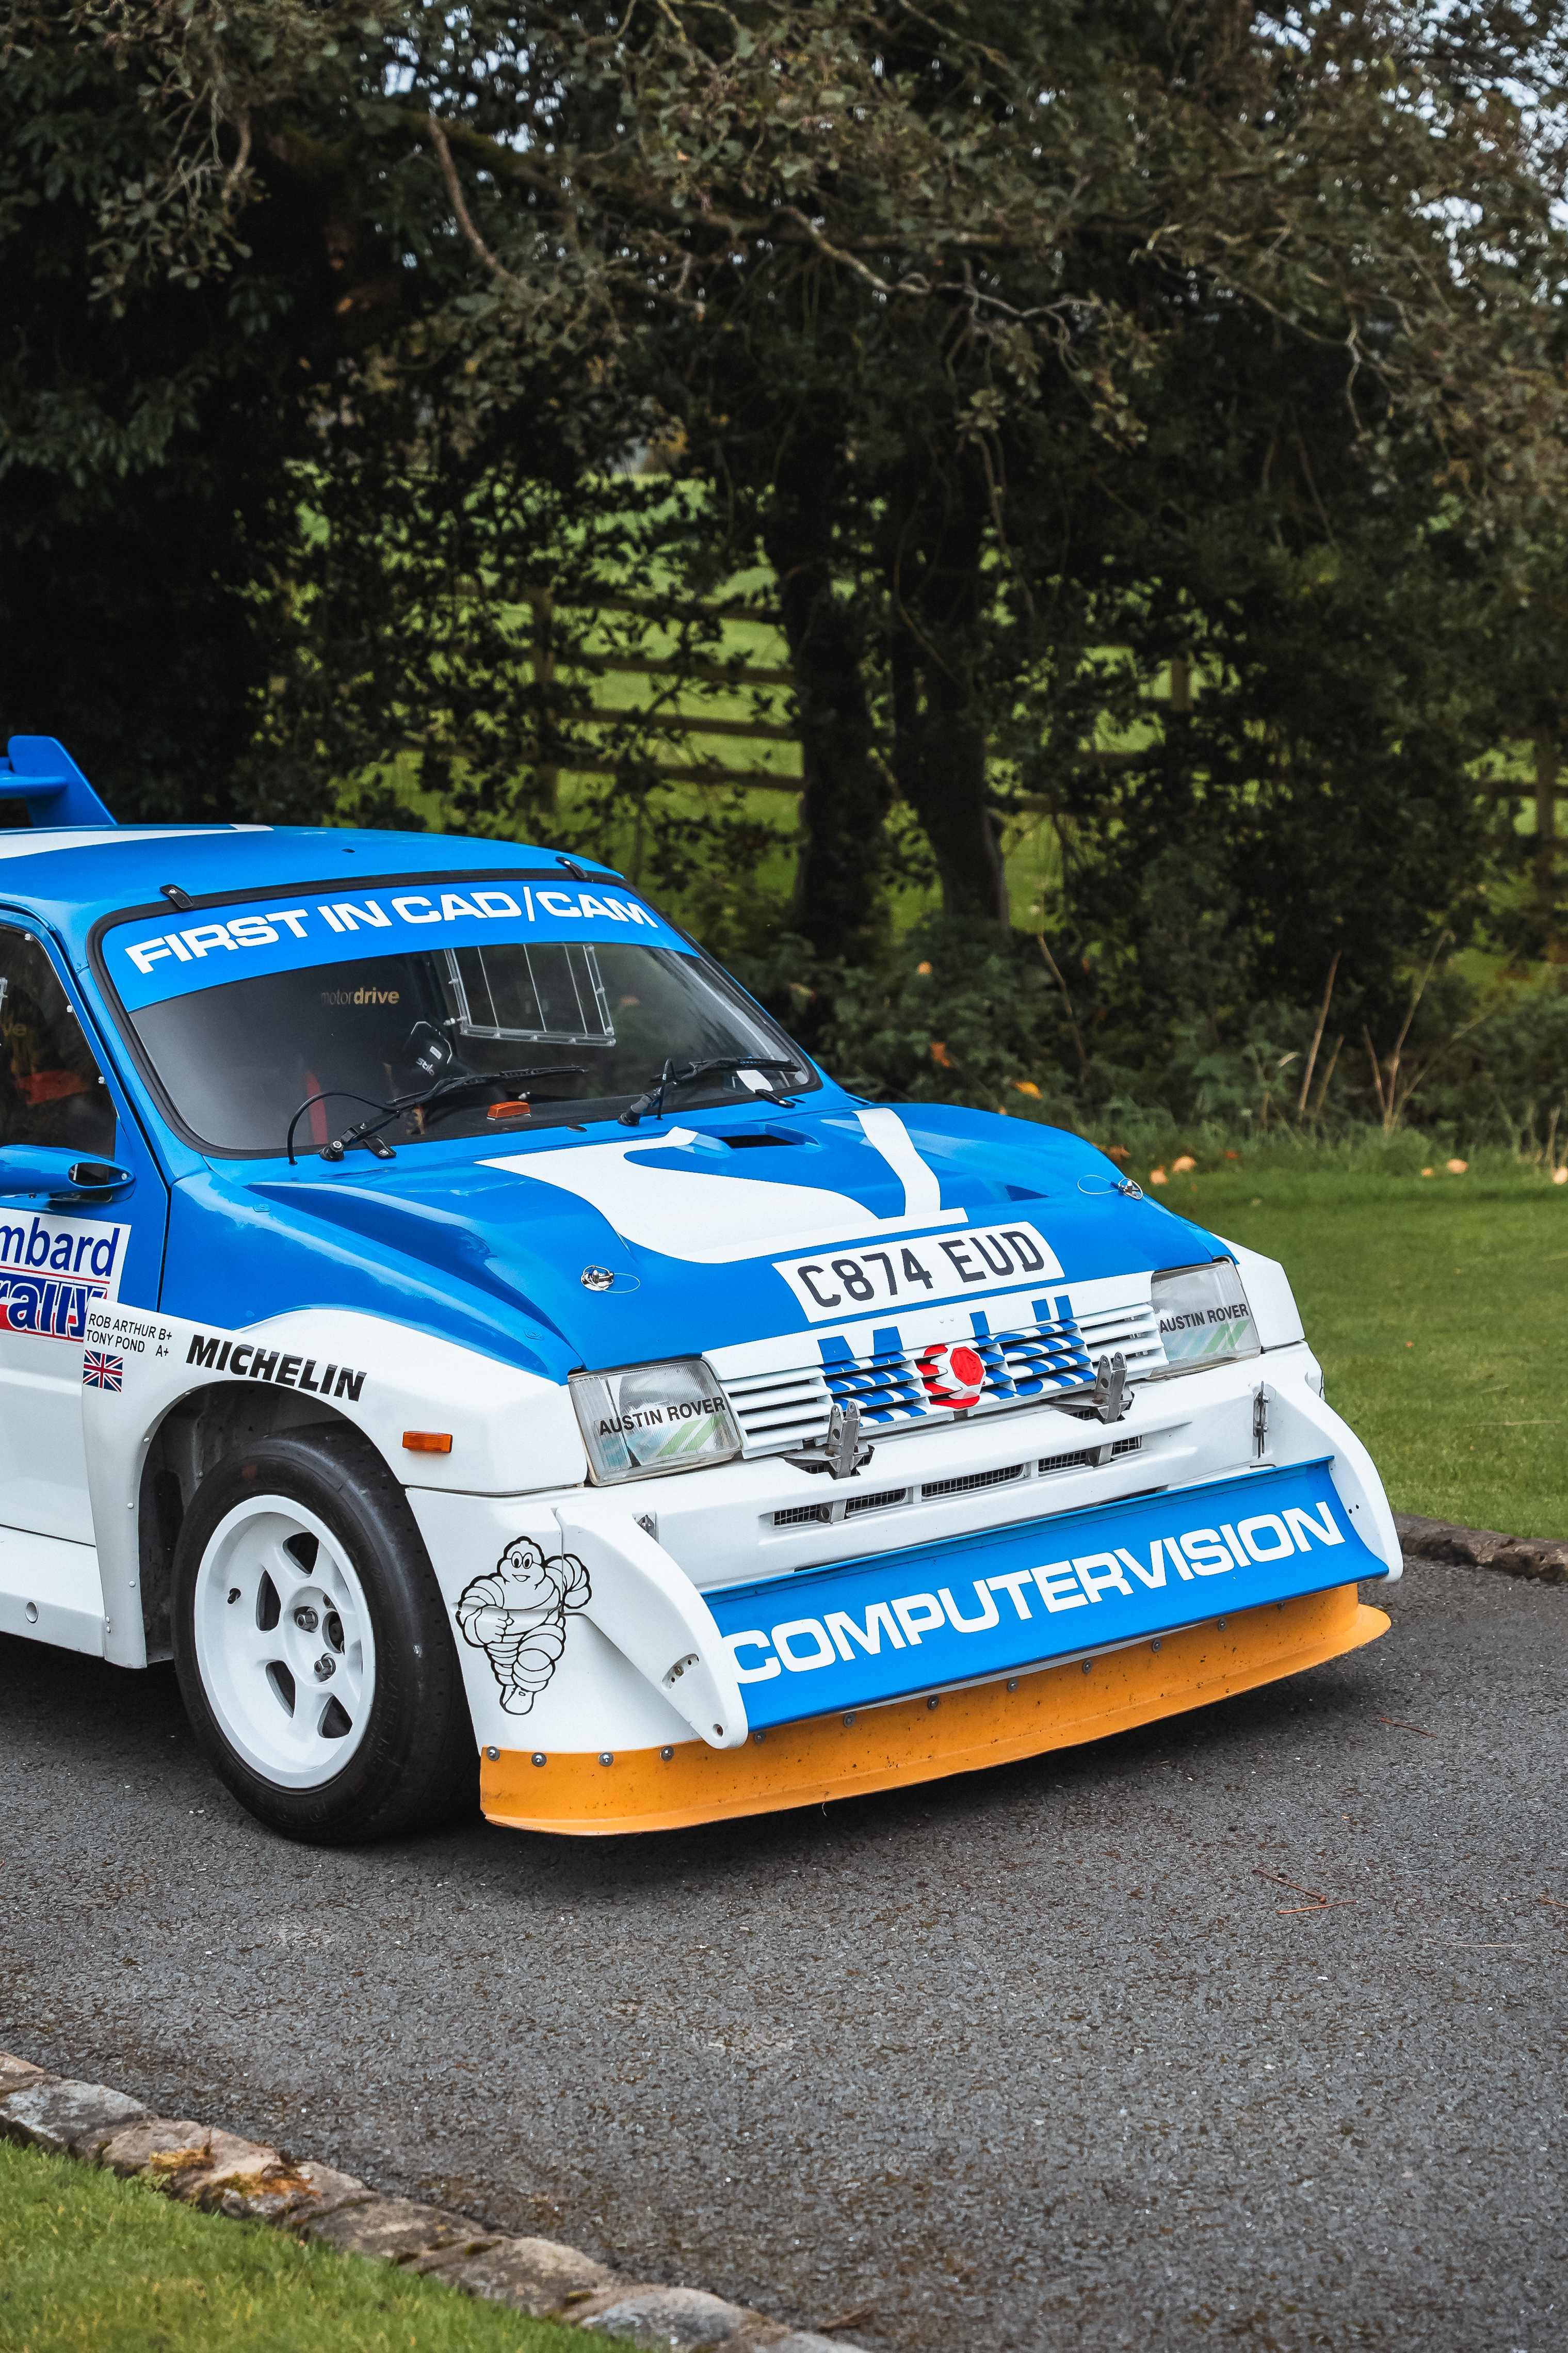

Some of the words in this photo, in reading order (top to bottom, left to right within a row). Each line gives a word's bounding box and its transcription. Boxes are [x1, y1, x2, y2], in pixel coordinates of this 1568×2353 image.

[124, 908, 309, 974] FIRST
[317, 900, 392, 933] IN
[391, 886, 659, 928] CAD/CAM
[797, 1248, 932, 1307] C874
[937, 1231, 1044, 1283] EUD
[87, 1329, 114, 1346] TONY
[115, 1336, 145, 1353] POND
[155, 1344, 169, 1357] A+
[89, 1314, 111, 1328] ROB
[112, 1319, 156, 1338] ARTHUR
[158, 1328, 172, 1340] B+
[1160, 1311, 1205, 1333] AUSTIN
[1207, 1303, 1249, 1323] ROVER
[186, 1334, 367, 1402] MICHELIN
[600, 1410, 662, 1436] AUSTIN
[667, 1397, 725, 1421] ROVER
[723, 1501, 1346, 1684] COMPUTERVISION
